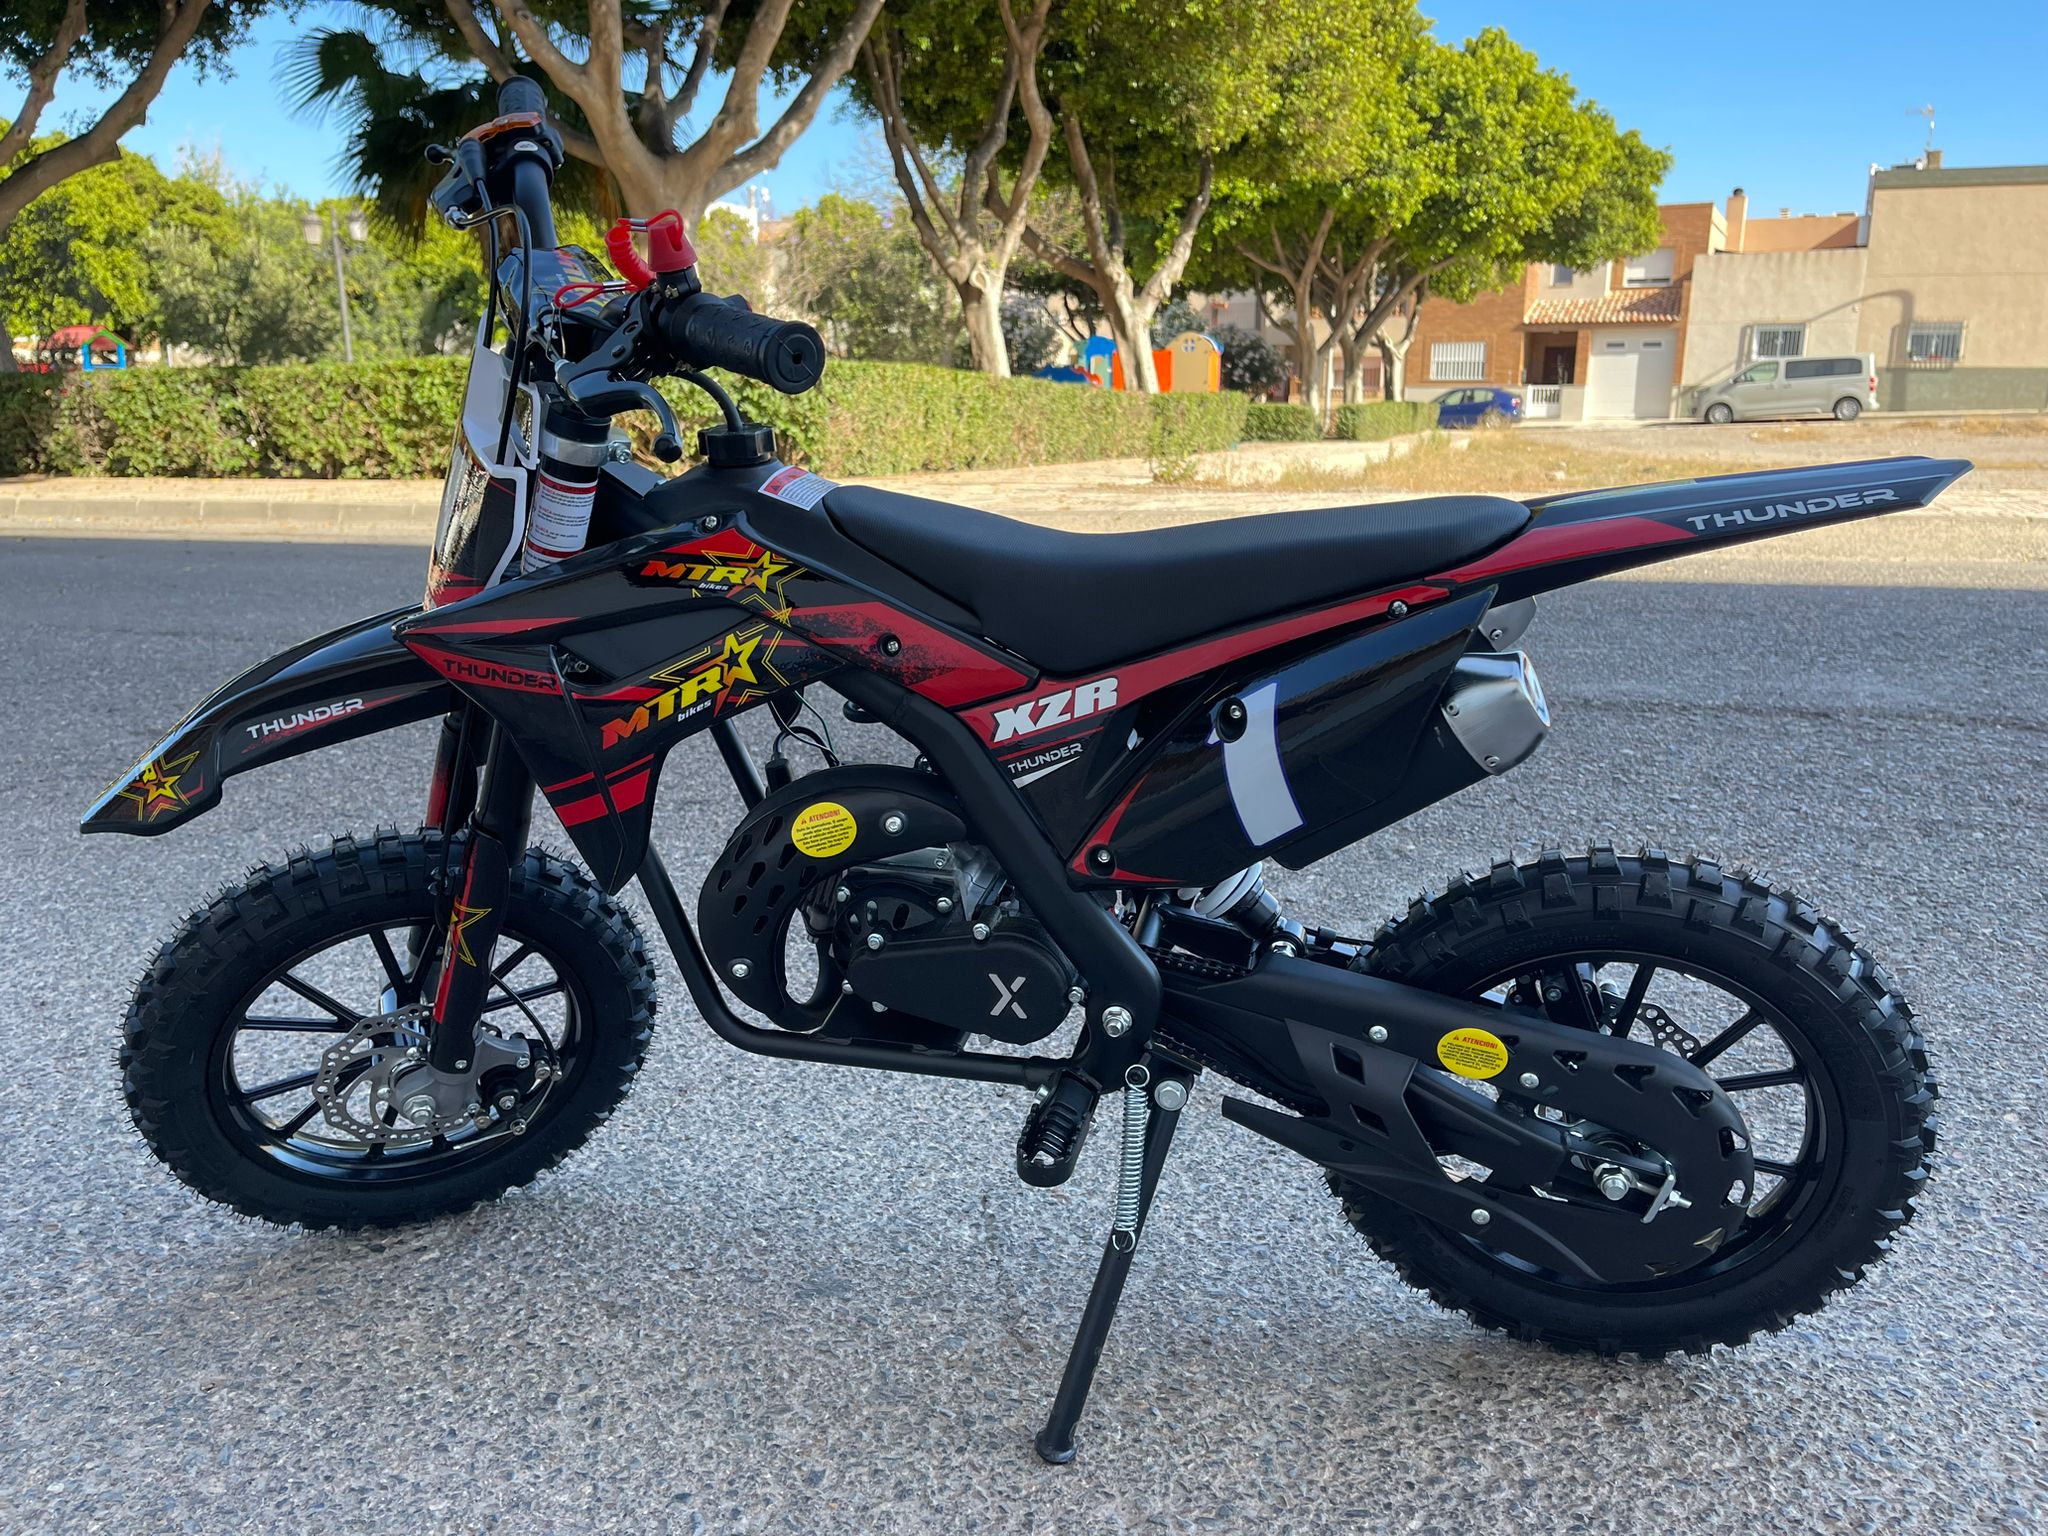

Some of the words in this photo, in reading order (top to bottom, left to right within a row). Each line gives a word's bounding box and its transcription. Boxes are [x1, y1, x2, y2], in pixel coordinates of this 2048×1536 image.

[1686, 488, 1900, 531] THUNDER
[640, 560, 749, 584] MTR
[698, 582, 729, 591] bikes
[442, 658, 558, 691] THUNDER
[246, 698, 365, 739] THUNDER
[600, 666, 723, 750] MTR
[677, 699, 712, 722] bikes
[993, 677, 1118, 743] XZR
[1007, 742, 1084, 774] THUNDER
